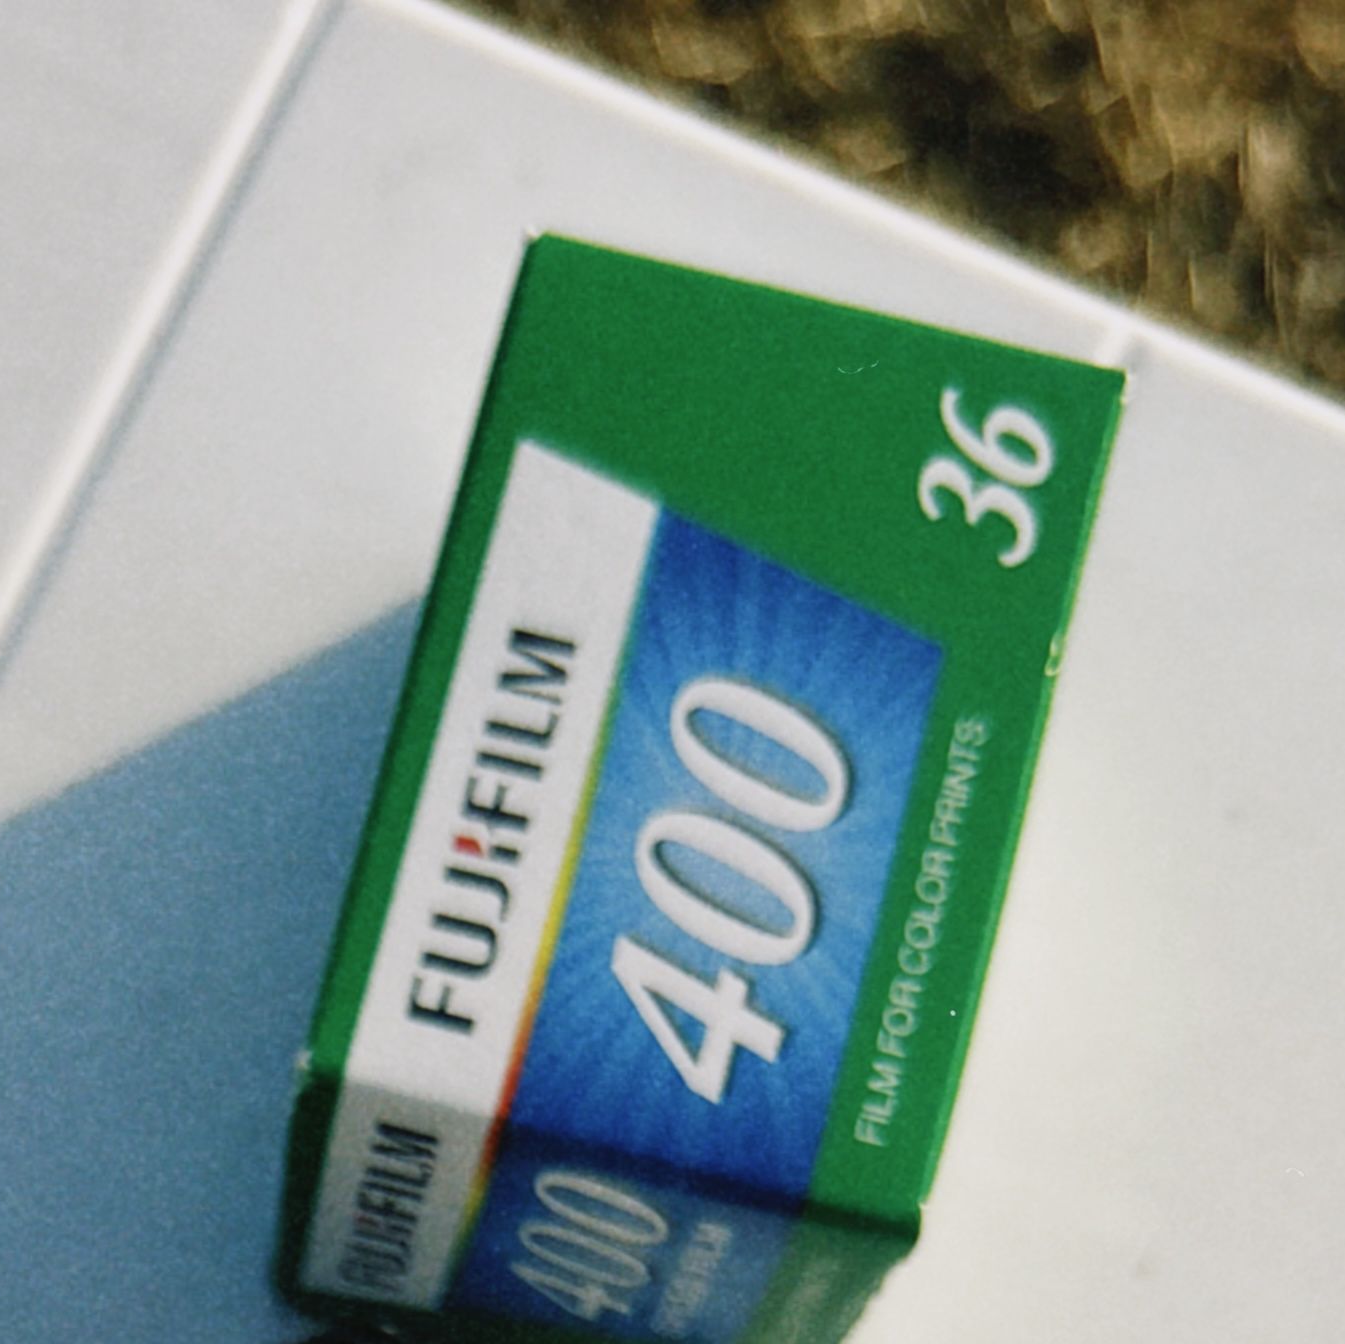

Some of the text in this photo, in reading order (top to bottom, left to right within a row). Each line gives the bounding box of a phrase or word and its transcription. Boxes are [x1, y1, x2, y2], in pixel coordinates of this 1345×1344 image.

[918, 387, 1052, 567] 36
[405, 629, 577, 1035] FUJIFILM
[612, 675, 850, 1104] 400
[853, 716, 989, 1147] FILM FOR COLOR PRINTS
[510, 1169, 668, 1322] 400
